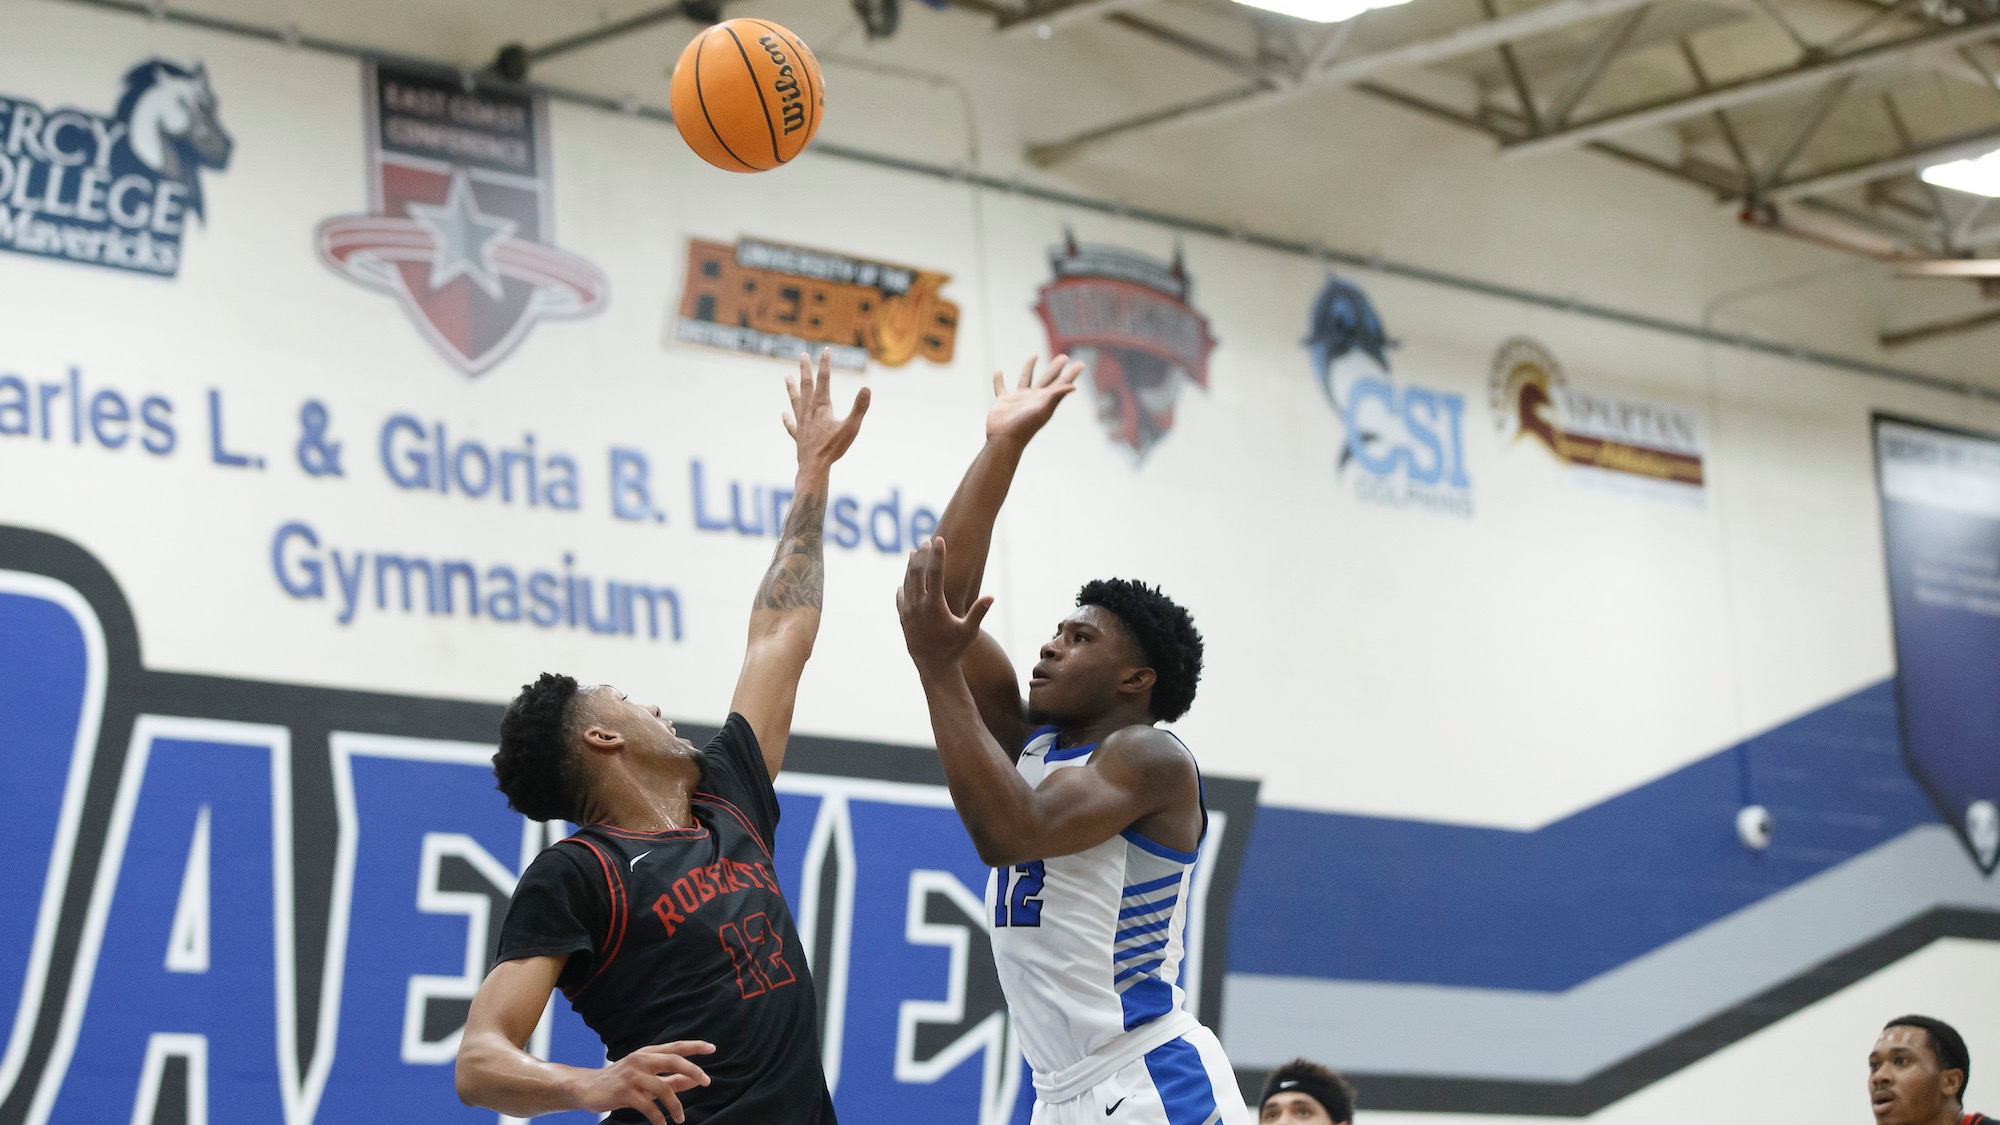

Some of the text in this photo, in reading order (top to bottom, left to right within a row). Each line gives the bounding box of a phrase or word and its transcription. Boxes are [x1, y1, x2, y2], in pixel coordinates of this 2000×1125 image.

[758, 34, 805, 136] Wilson
[0, 100, 127, 178] RCY
[207, 388, 266, 469] L.
[297, 398, 346, 477] &
[379, 413, 581, 511] Gloria
[610, 447, 666, 524] B.
[690, 458, 940, 554] Lusde
[1343, 377, 1472, 488] CSI
[271, 521, 684, 642] Gymnasium
[652, 857, 781, 938] ROBERTS
[994, 858, 1046, 928] 12
[718, 911, 797, 1000] 12
